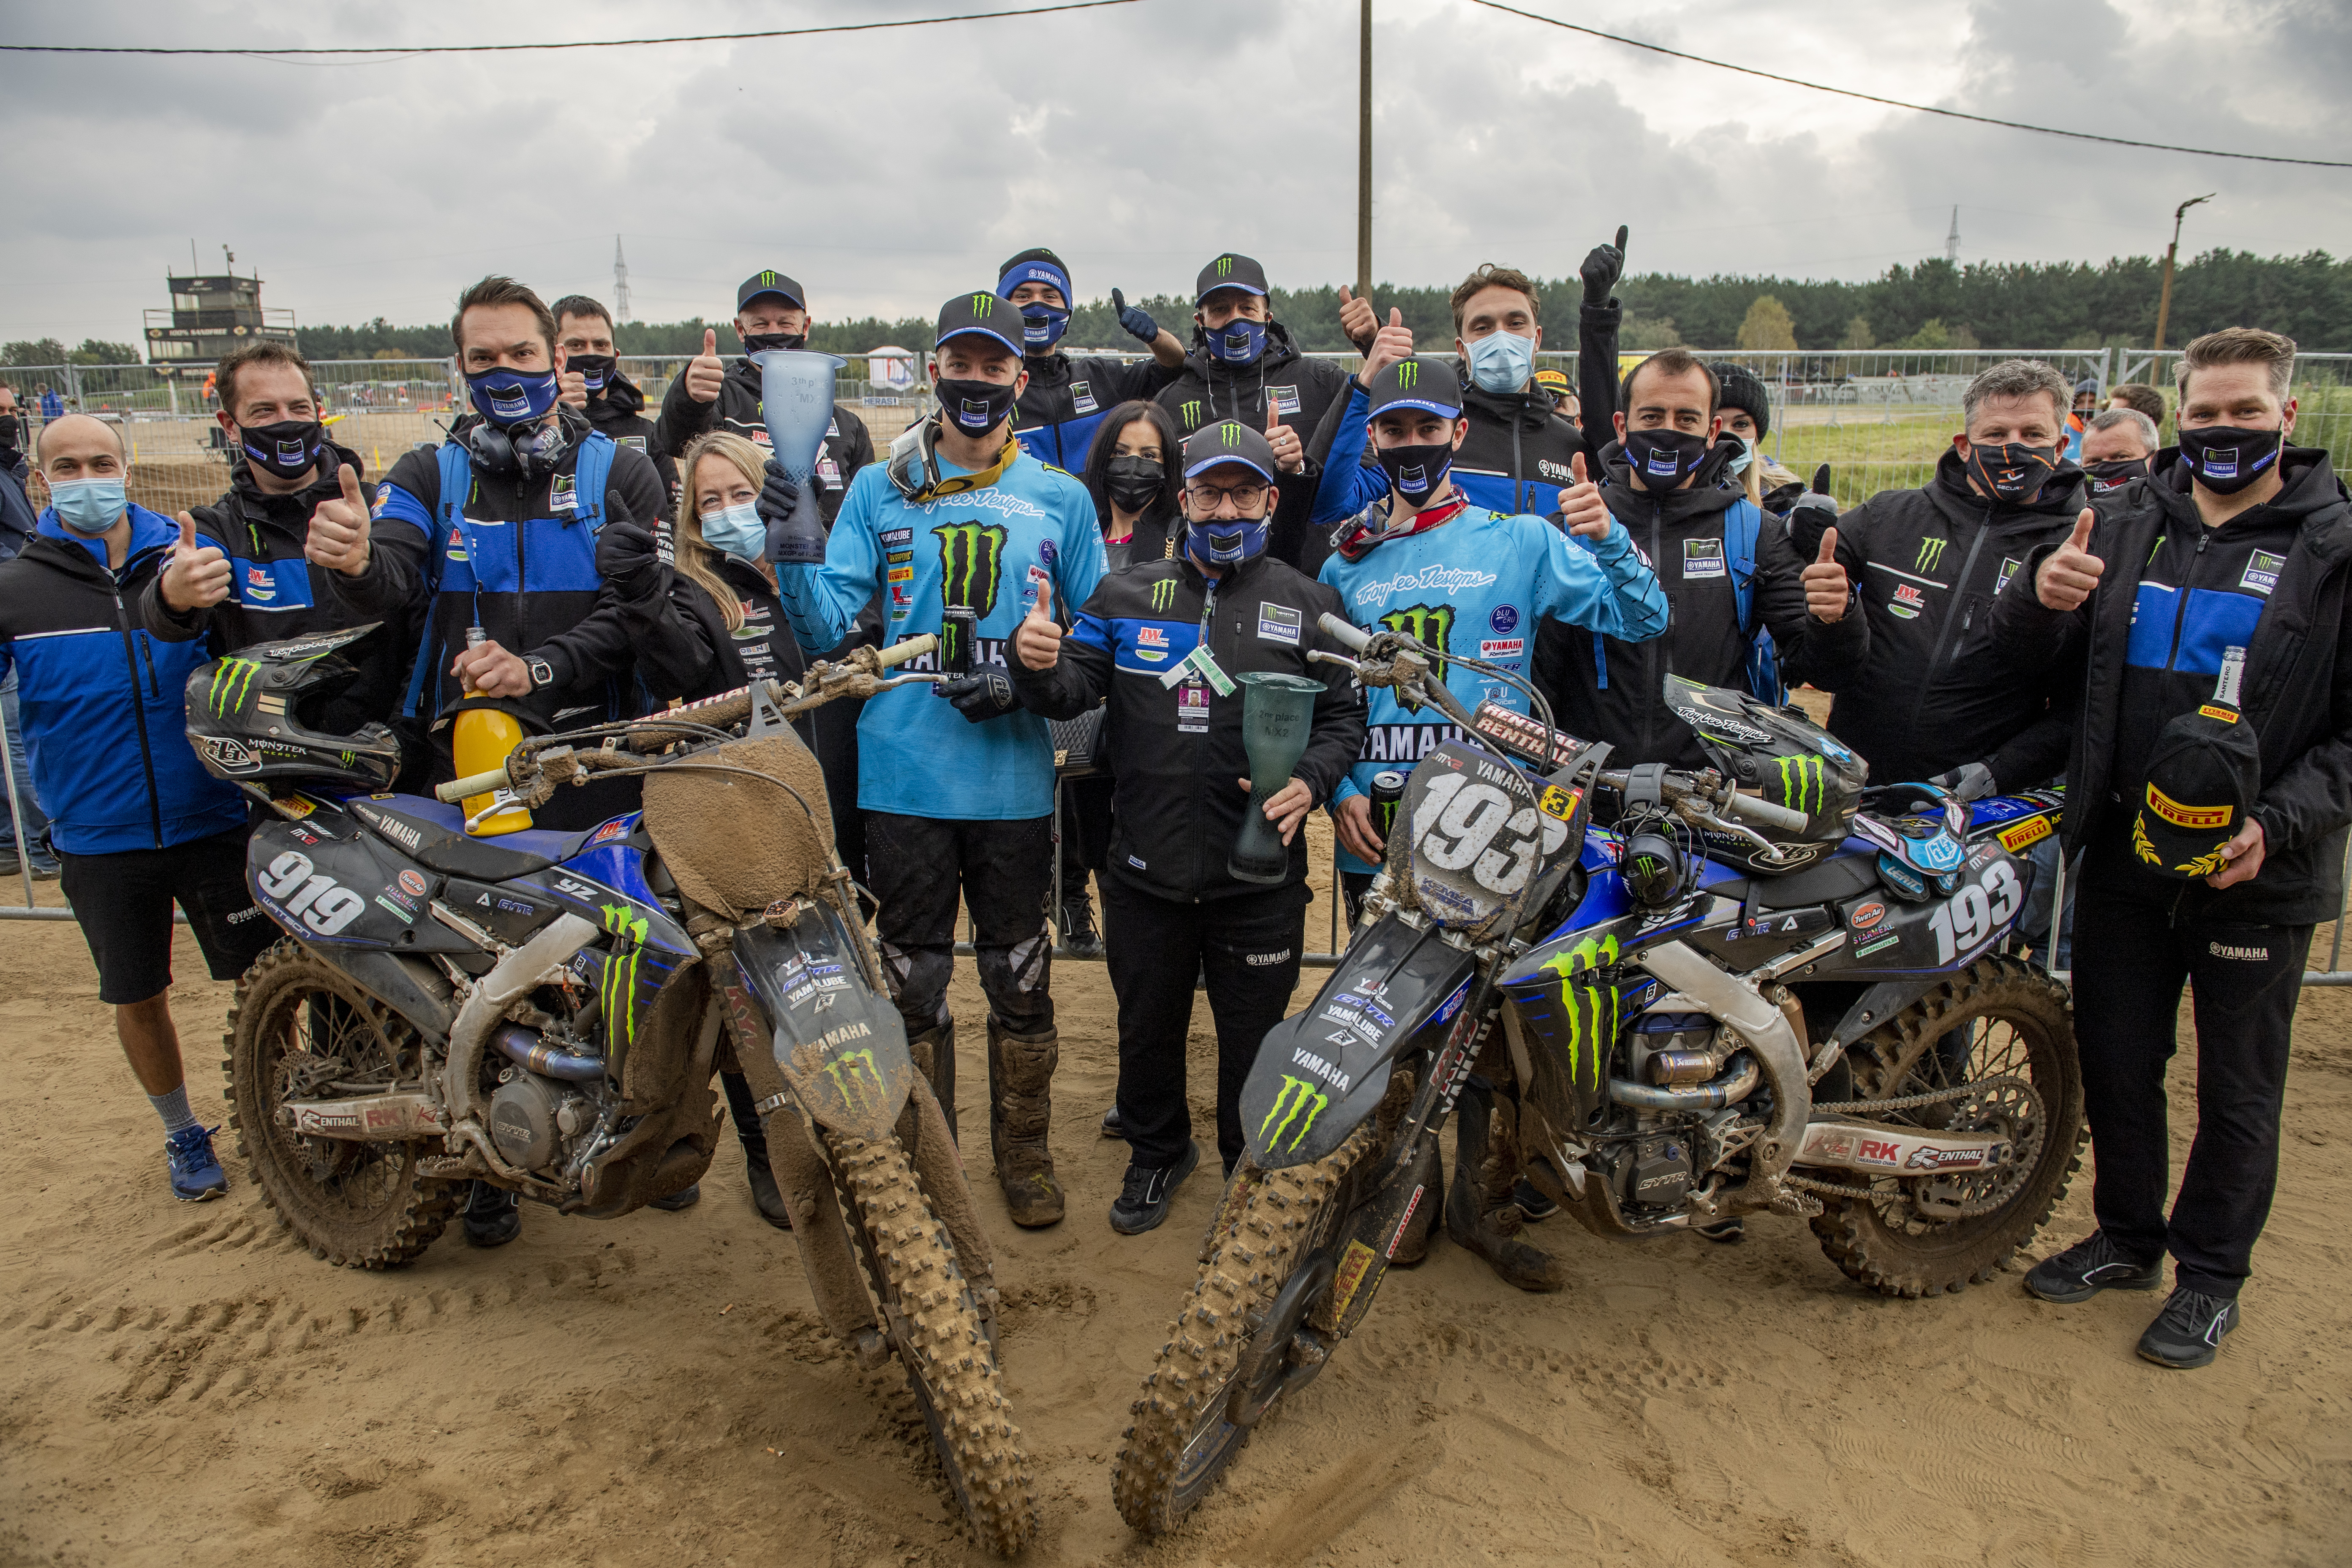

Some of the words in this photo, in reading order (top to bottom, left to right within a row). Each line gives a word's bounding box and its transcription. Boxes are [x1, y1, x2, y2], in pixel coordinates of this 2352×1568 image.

[1037, 270, 1061, 286] YAMAHA
[502, 400, 526, 409] YAMAHA
[1391, 400, 1436, 409] YAMAHA
[1406, 480, 1425, 488] YAMAHA
[1543, 473, 1573, 484] RACIN
[937, 489, 972, 508] Lee
[972, 487, 1045, 518] Designs
[1415, 507, 1460, 534] PROGRIP
[881, 530, 910, 544] YAMALUBE
[657, 548, 675, 560] MALUB
[1218, 549, 1241, 560] YAMAHA
[1694, 561, 1721, 569] YAMAHA
[1356, 580, 1391, 607] Troy
[1391, 572, 1418, 591] Lee
[1418, 564, 1497, 596] Designs
[1139, 628, 1164, 640] JW
[1271, 623, 1296, 636] YAMAHA
[1492, 640, 1522, 651] YAMAHA
[942, 672, 966, 680] STER
[2219, 665, 2231, 699] SANTERO
[1678, 707, 1701, 724] Troy
[1701, 713, 1724, 727] Lee
[1723, 718, 1771, 740] Designs
[2202, 707, 2235, 721] PIRELLI
[1483, 705, 1579, 749] RENTHAL
[248, 738, 307, 755] MONSTER
[256, 749, 297, 759] ENERGY
[1436, 752, 1464, 771] MX2
[1476, 759, 1534, 798] YAMAHA
[1546, 792, 1570, 817] 3
[2150, 790, 2225, 825] PIRELLI
[289, 828, 320, 845] MX2
[379, 814, 422, 849] YAMAHA
[1413, 772, 1568, 895] 193
[1704, 831, 1751, 842] MONST
[2004, 819, 2047, 848] PIRELLI
[1968, 844, 1997, 870] MX2
[401, 873, 414, 887] Twin
[414, 882, 424, 892] Air
[1887, 866, 1922, 888] LEATT
[258, 850, 365, 936] 919
[385, 884, 419, 912] STARMEAL
[553, 878, 599, 901] YZ
[237, 905, 259, 920] YAMA
[262, 896, 311, 938] WATSON
[498, 898, 535, 917] GYTR
[1854, 910, 1873, 924] Twin
[1870, 907, 1883, 918] Air
[1928, 860, 2022, 965] 193
[232, 912, 262, 925] RACIN
[1726, 922, 1772, 941] GTR
[1853, 922, 1895, 945] STARMEAL
[1863, 936, 1898, 955] CORPELLETS.BE
[1957, 922, 2012, 967] GEERTS
[2220, 945, 2268, 958] YAMAHA
[1257, 948, 1290, 964] YAMAHA
[786, 958, 829, 977] SERCES
[783, 964, 843, 994] GYTR
[787, 976, 847, 1003] YAMALUBE
[1334, 994, 1395, 1029] GYTR
[1327, 1004, 1383, 1042] YAMALUBE
[1292, 1047, 1350, 1092] YAMAHA
[302, 1109, 360, 1132] RENTHAL
[366, 1109, 403, 1127] RK
[496, 1122, 531, 1139] GYTR
[1858, 1140, 1902, 1161] RK
[1907, 1146, 1984, 1169] RENTHAL
[1857, 1157, 1882, 1165] TAKASAGO
[1638, 1171, 1687, 1190] GYTR
